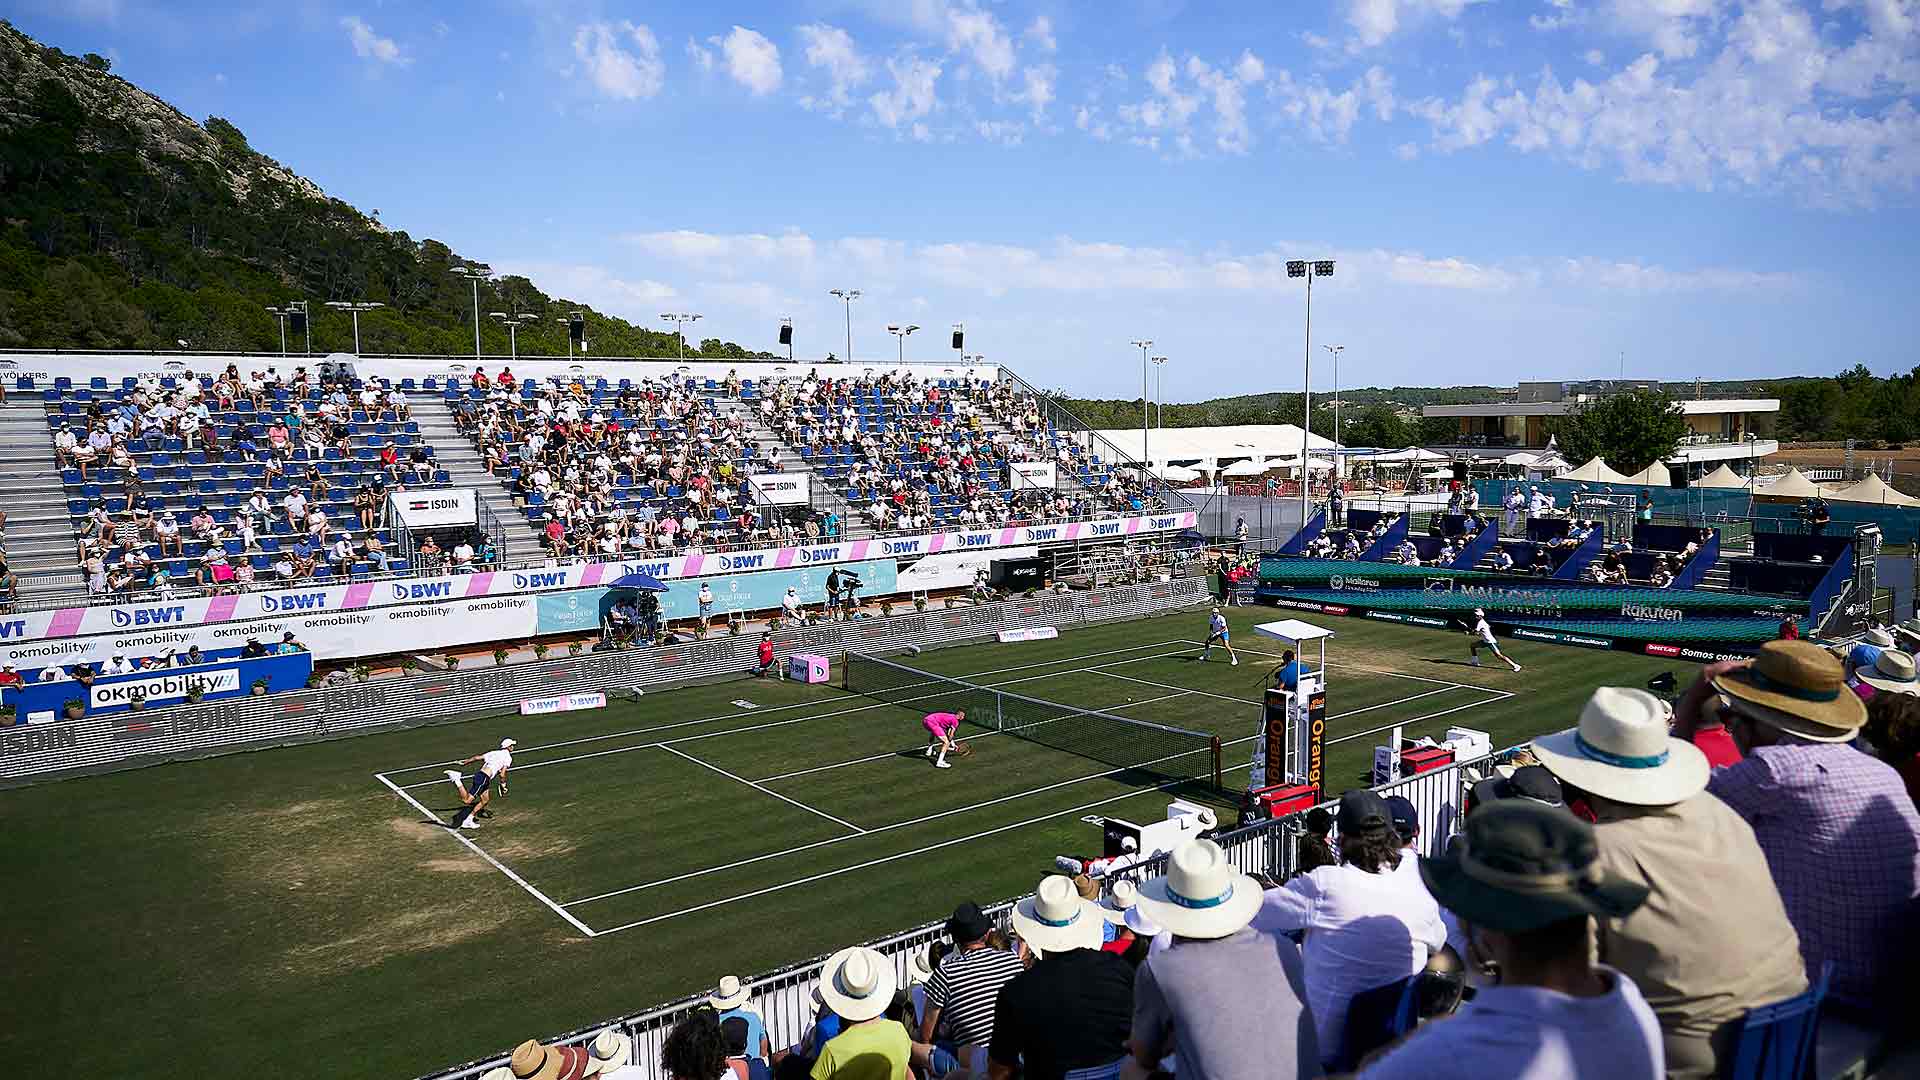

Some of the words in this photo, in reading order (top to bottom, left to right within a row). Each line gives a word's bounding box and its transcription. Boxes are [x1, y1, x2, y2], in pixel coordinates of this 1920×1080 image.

[776, 482, 797, 490] ISDIN
[431, 499, 458, 509] ISDIN
[1099, 523, 1119, 535] BWT
[1157, 518, 1176, 529] BWT
[966, 534, 992, 546] BWT
[1035, 529, 1056, 541] BWT
[892, 541, 919, 553] BWT
[812, 548, 840, 561] BWT
[731, 554, 764, 569] BWT
[636, 562, 669, 576] BWT
[530, 572, 566, 588] BWT
[411, 581, 452, 599] BWT
[282, 593, 326, 611] BWT
[1277, 599, 1297, 607] Somos
[135, 606, 184, 625] BWT
[1621, 602, 1682, 621] Rakuten
[1681, 648, 1714, 660] Somos
[536, 700, 559, 710] BWT
[577, 697, 600, 707] BWT
[1267, 719, 1284, 786] Orang
[1309, 719, 1324, 790] Orange
